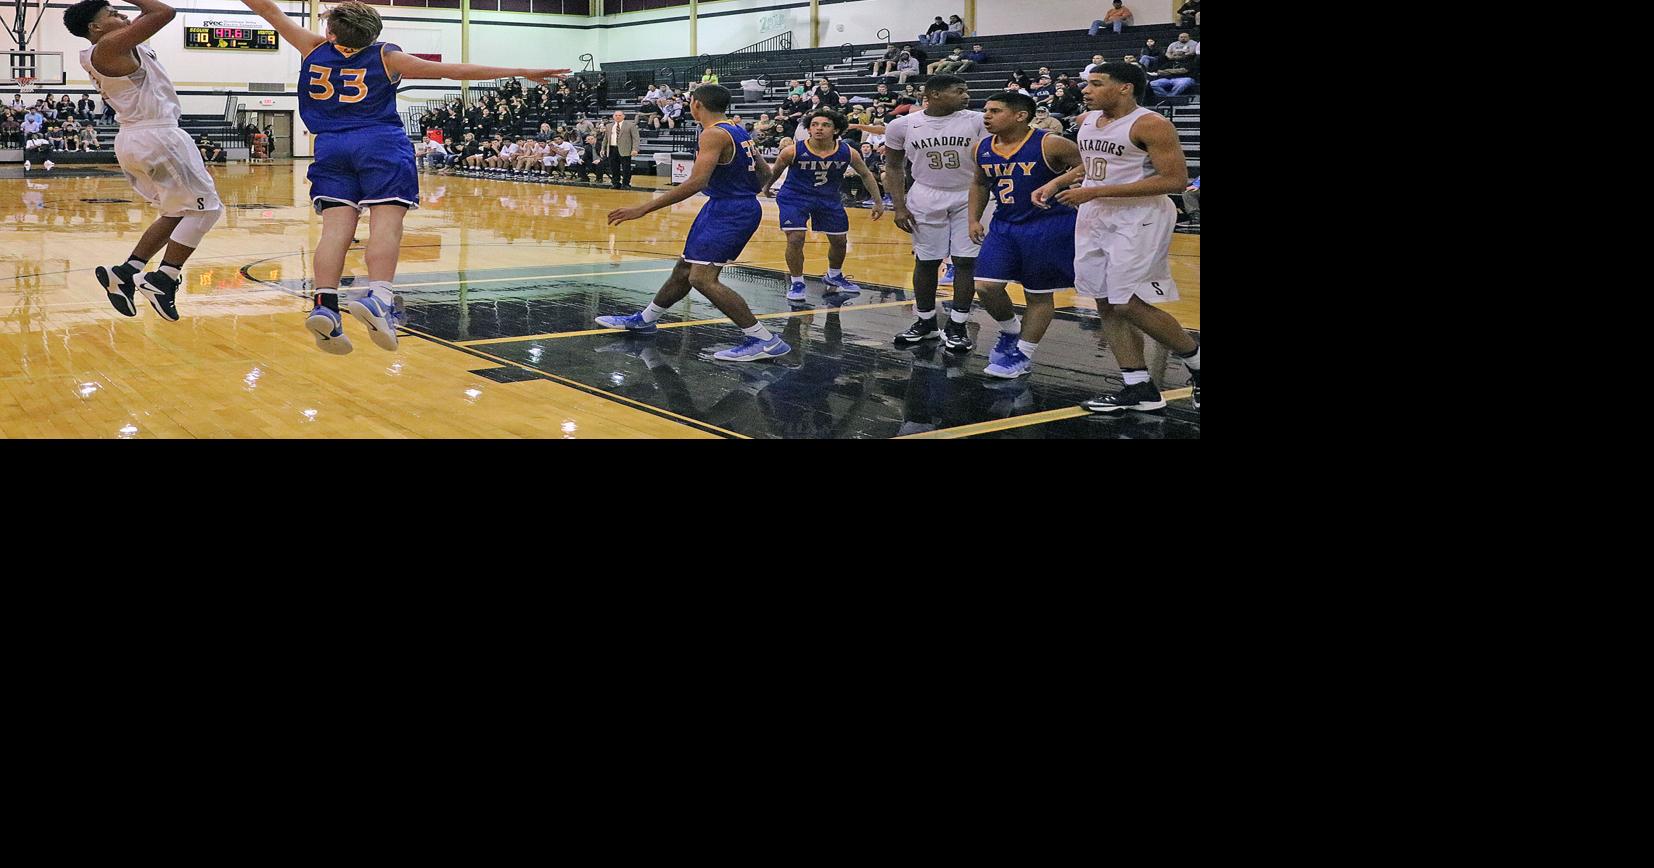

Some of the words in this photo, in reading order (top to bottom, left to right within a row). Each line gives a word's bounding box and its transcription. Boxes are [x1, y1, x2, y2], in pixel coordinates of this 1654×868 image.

[309, 64, 368, 103] 33
[911, 136, 972, 150] MATADORS
[1079, 139, 1125, 156] ATADORS
[798, 160, 846, 170] TIVY
[926, 150, 960, 170] 33
[981, 161, 1037, 178] TIVY
[1085, 156, 1108, 182] 10
[814, 171, 829, 187] 3
[997, 178, 1015, 204] 2
[196, 197, 205, 210] S
[1151, 281, 1164, 296] S
